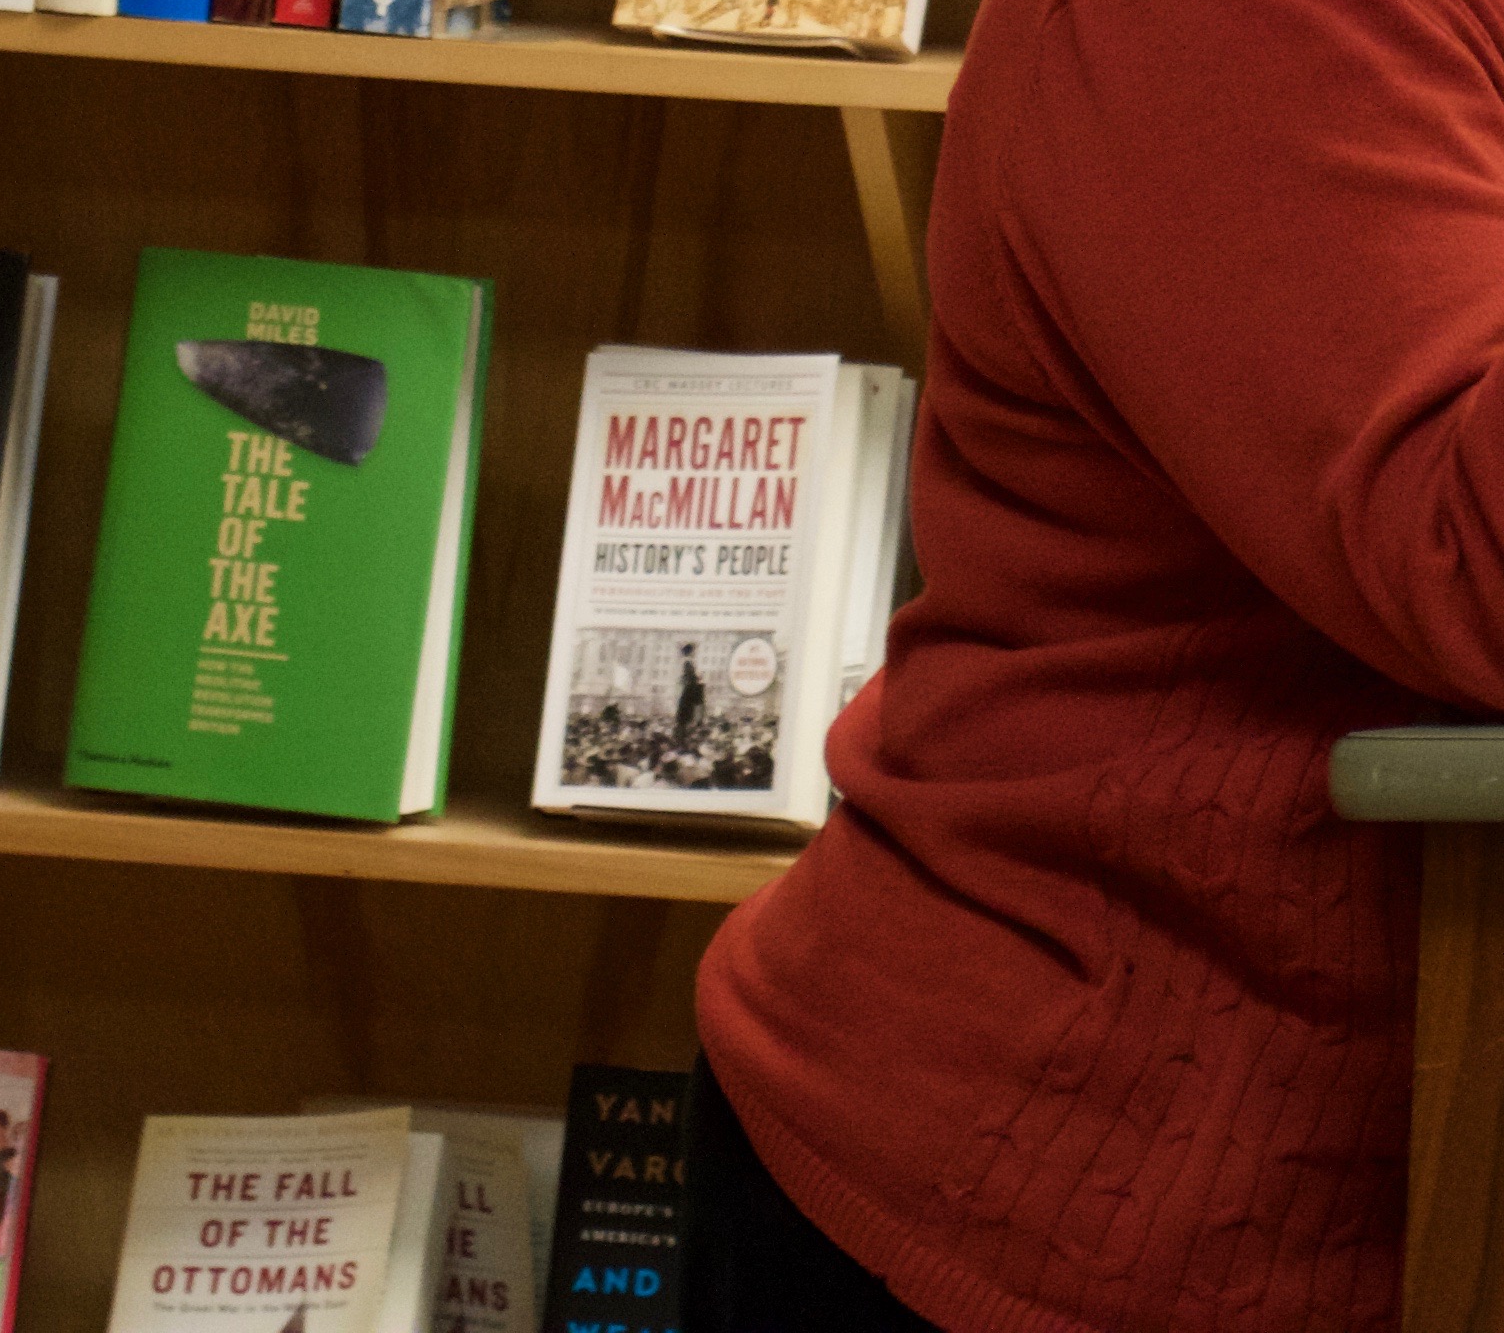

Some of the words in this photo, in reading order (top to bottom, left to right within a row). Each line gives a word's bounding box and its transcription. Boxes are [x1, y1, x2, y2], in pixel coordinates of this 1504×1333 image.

[247, 300, 320, 326] DAVID
[226, 432, 296, 475] THE
[602, 413, 806, 471] MARGARET
[221, 475, 311, 521] TALE
[218, 516, 268, 558] OF
[593, 540, 706, 577] HISTORY'S
[713, 543, 790, 578] PEOPLE
[208, 560, 277, 604] THE
[203, 601, 279, 648] AXE
[186, 1171, 260, 1202] THE
[275, 1168, 358, 1201] FALL
[200, 1218, 245, 1248] OF
[259, 1216, 331, 1247] THE
[152, 1261, 359, 1294] OTTOMANS
